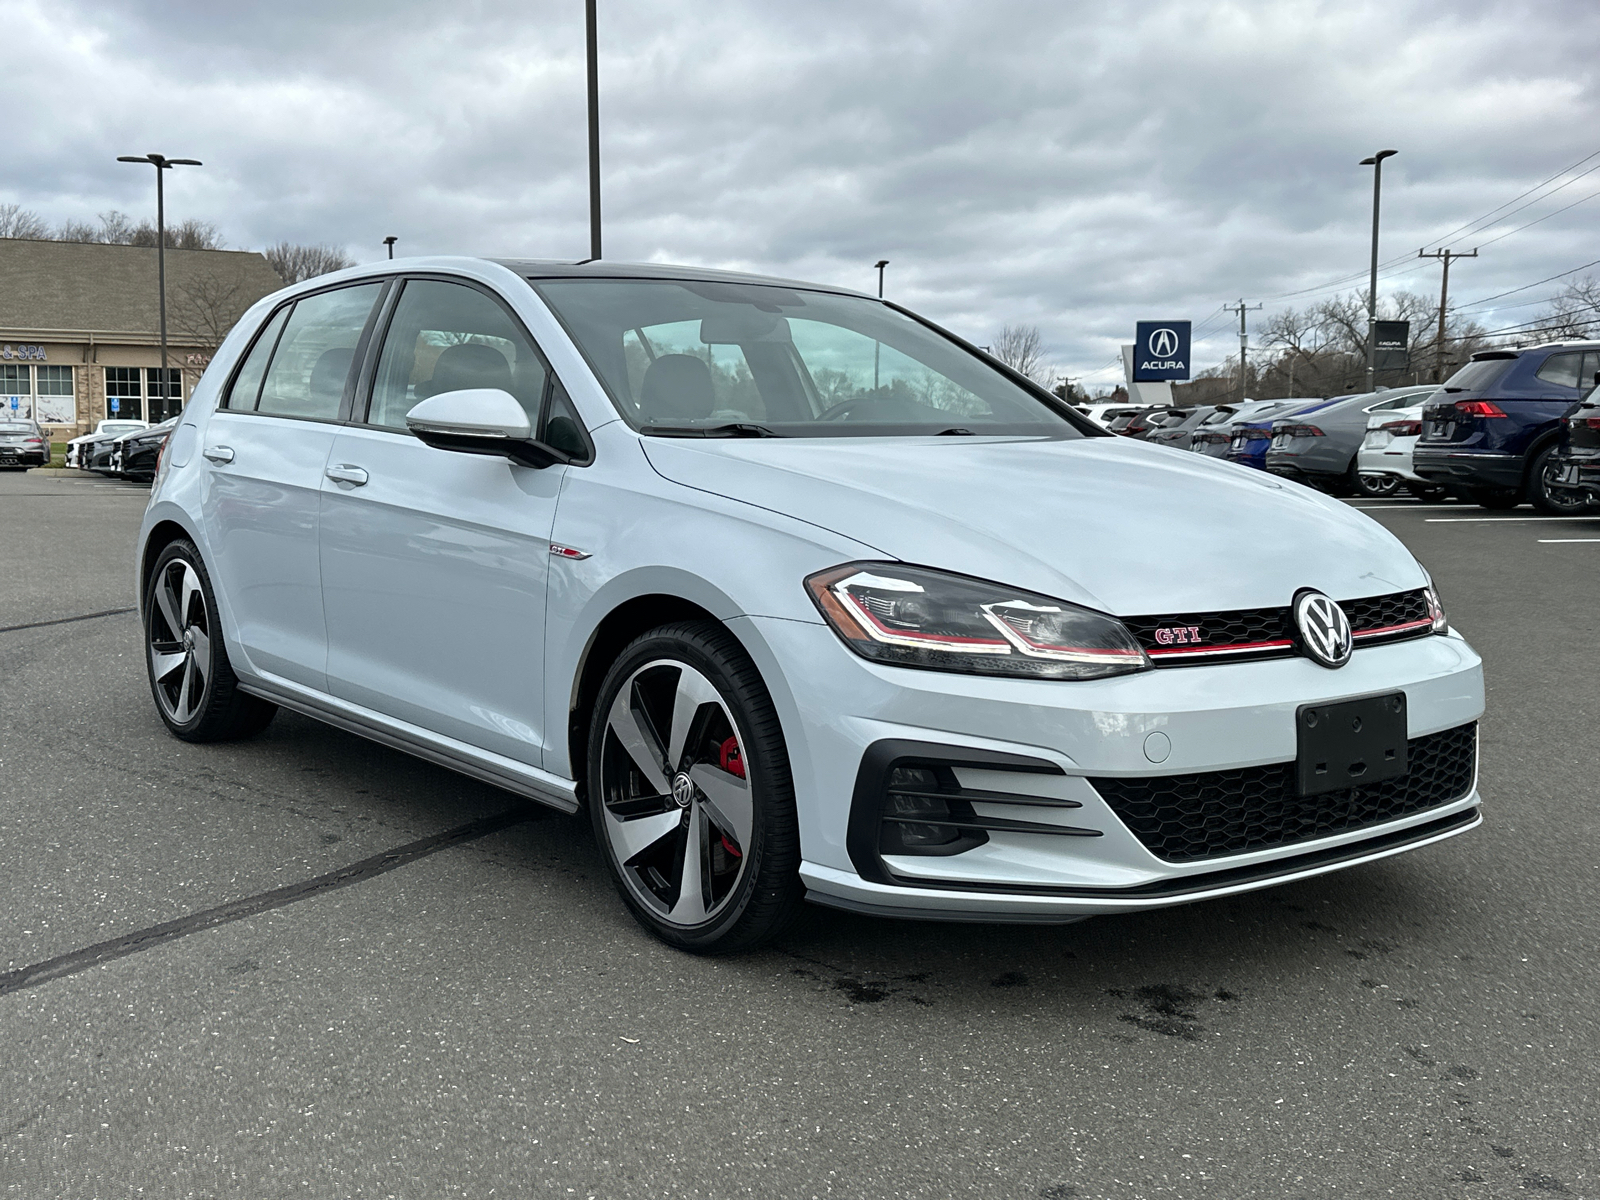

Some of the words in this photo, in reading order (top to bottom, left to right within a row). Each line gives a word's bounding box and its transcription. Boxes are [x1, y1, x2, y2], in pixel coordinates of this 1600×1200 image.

[18, 345, 47, 360] SPA
[1141, 361, 1185, 370] ACURA
[1155, 626, 1202, 645] GTI
